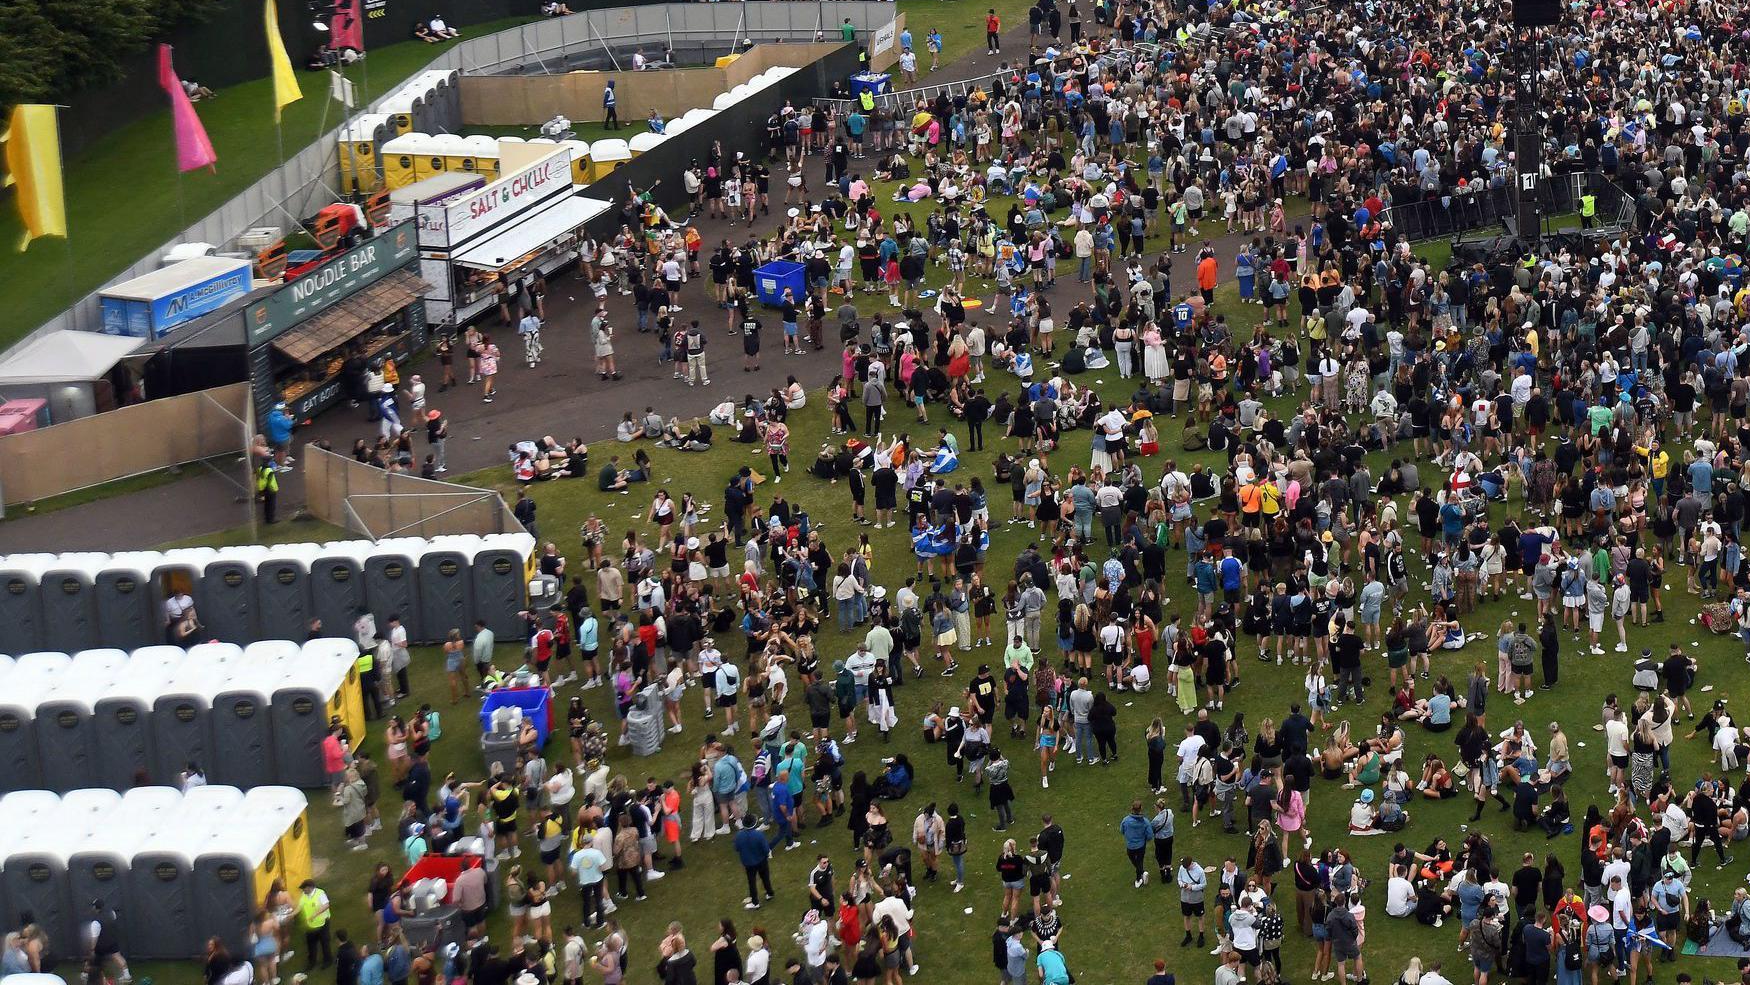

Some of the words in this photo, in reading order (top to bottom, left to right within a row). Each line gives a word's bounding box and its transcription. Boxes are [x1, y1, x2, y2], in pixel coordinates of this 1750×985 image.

[470, 190, 498, 219] SALT
[501, 187, 510, 203] &
[291, 260, 347, 303] NOODLE
[351, 245, 376, 272] BAR
[1178, 312, 1188, 320] 10
